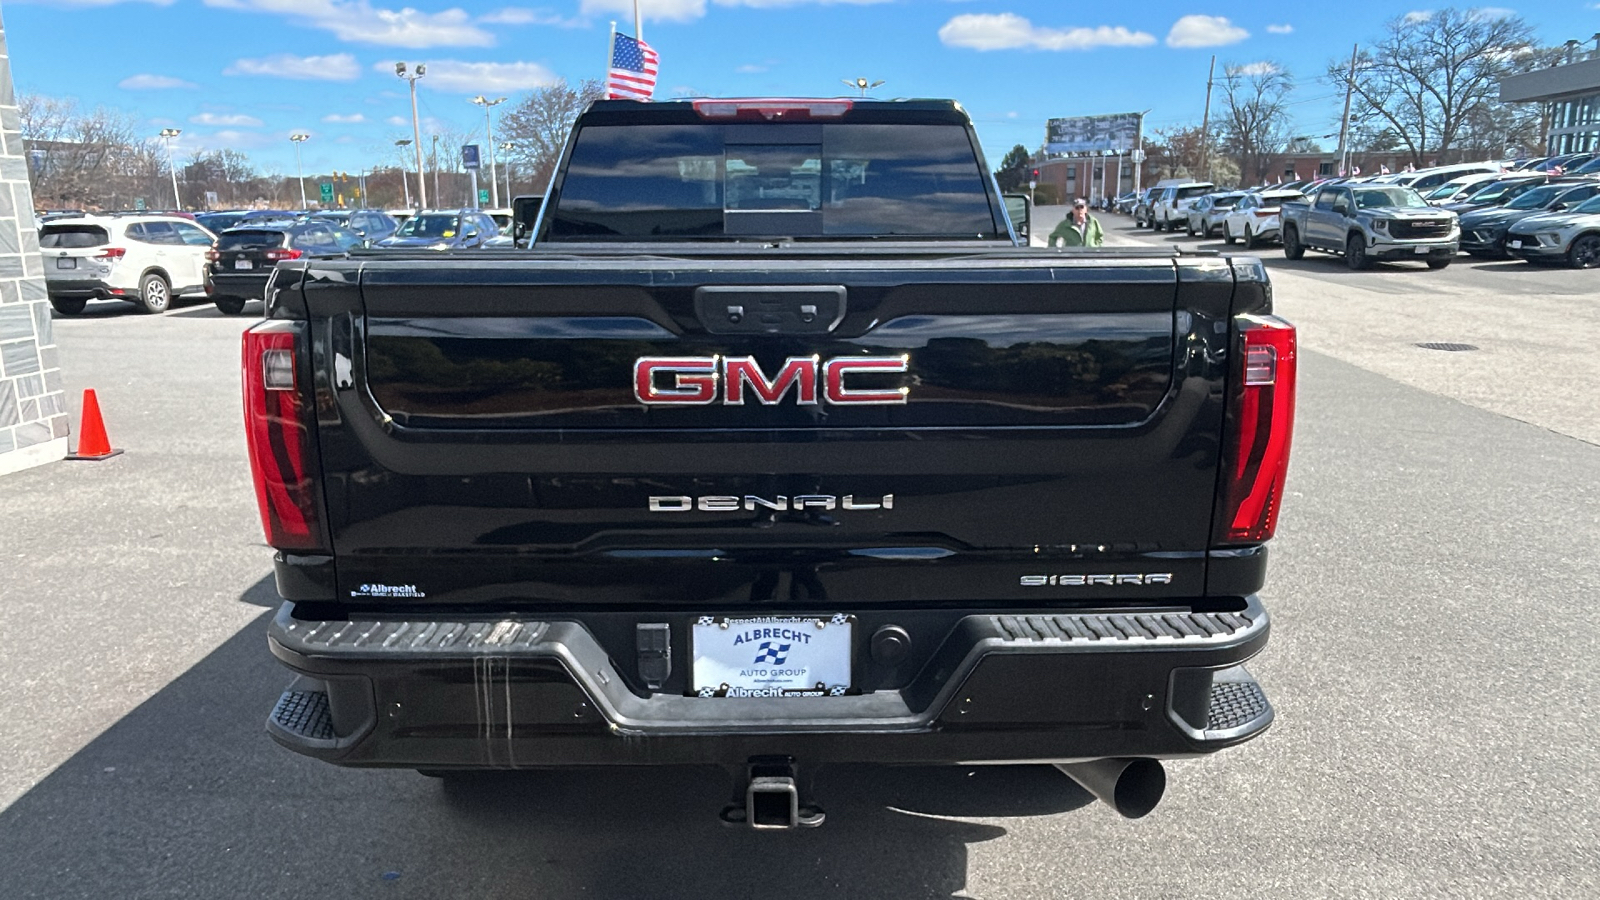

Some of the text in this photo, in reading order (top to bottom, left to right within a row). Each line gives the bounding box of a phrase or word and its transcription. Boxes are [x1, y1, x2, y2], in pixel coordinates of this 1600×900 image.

[634, 355, 910, 405] GMC
[649, 494, 894, 511] DENALI
[1020, 572, 1173, 586] SIERRA
[370, 584, 416, 593] Albrecht
[733, 628, 812, 646] ALBRECHT
[739, 669, 807, 677] AUTO GROUP
[725, 685, 784, 698] Albrecht
